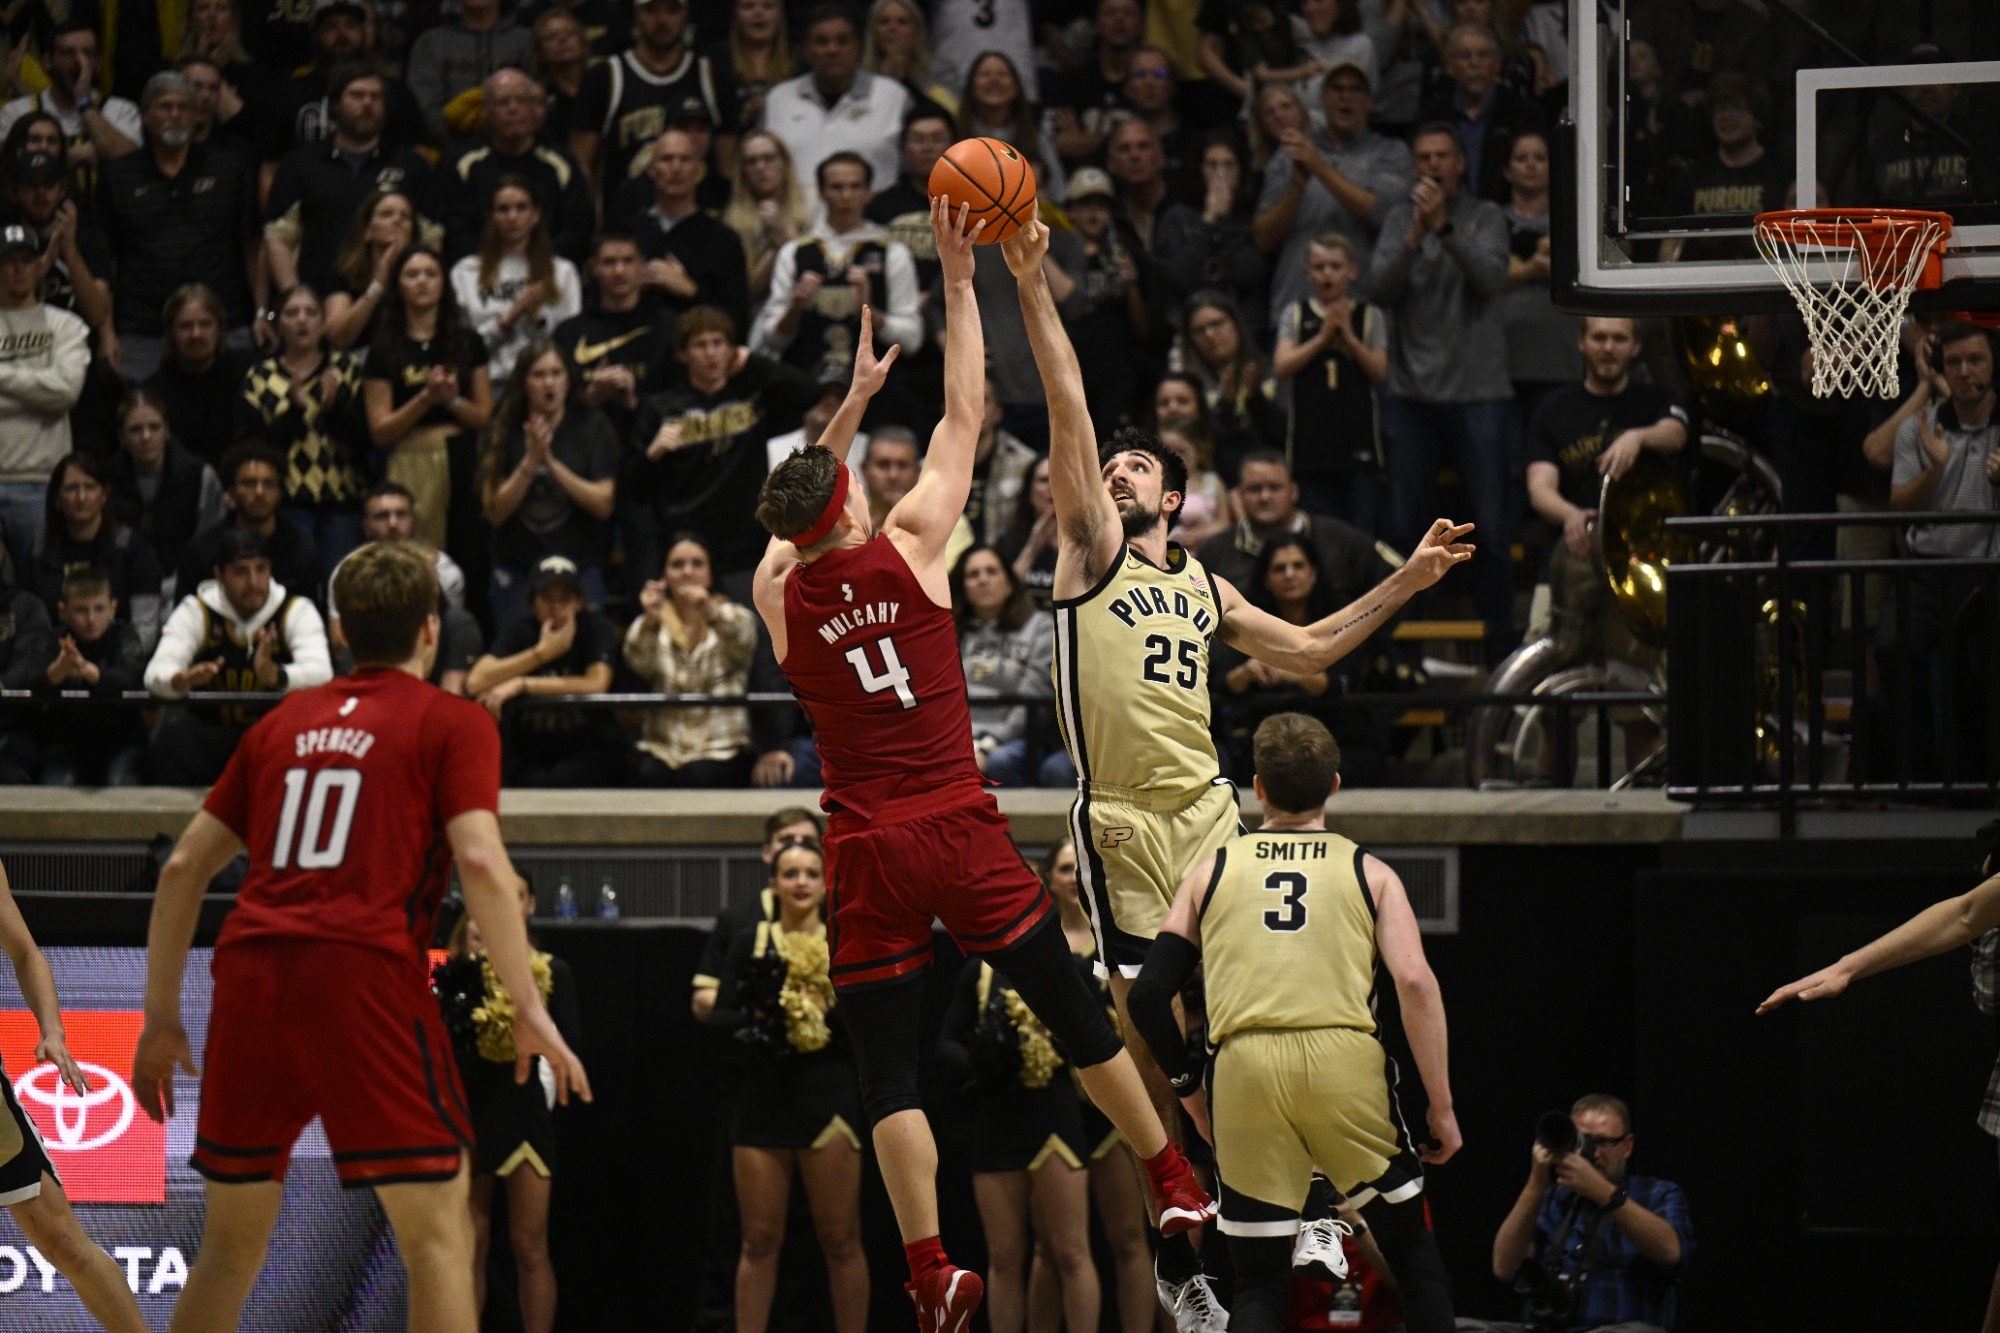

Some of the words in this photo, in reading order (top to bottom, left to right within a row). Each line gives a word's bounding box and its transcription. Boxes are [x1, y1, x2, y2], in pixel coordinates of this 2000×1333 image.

[1694, 185, 1765, 213] PURDUE
[1324, 358, 1339, 391] 1
[817, 601, 900, 646] MULCAHY
[844, 634, 919, 711] 4
[1142, 632, 1199, 691] 25
[295, 726, 376, 760] SPENCER
[270, 766, 364, 870] 10
[1101, 826, 1134, 848] P
[1255, 841, 1327, 860] SMITH
[1262, 870, 1309, 933] 3
[0, 1245, 188, 1294] OYTA
